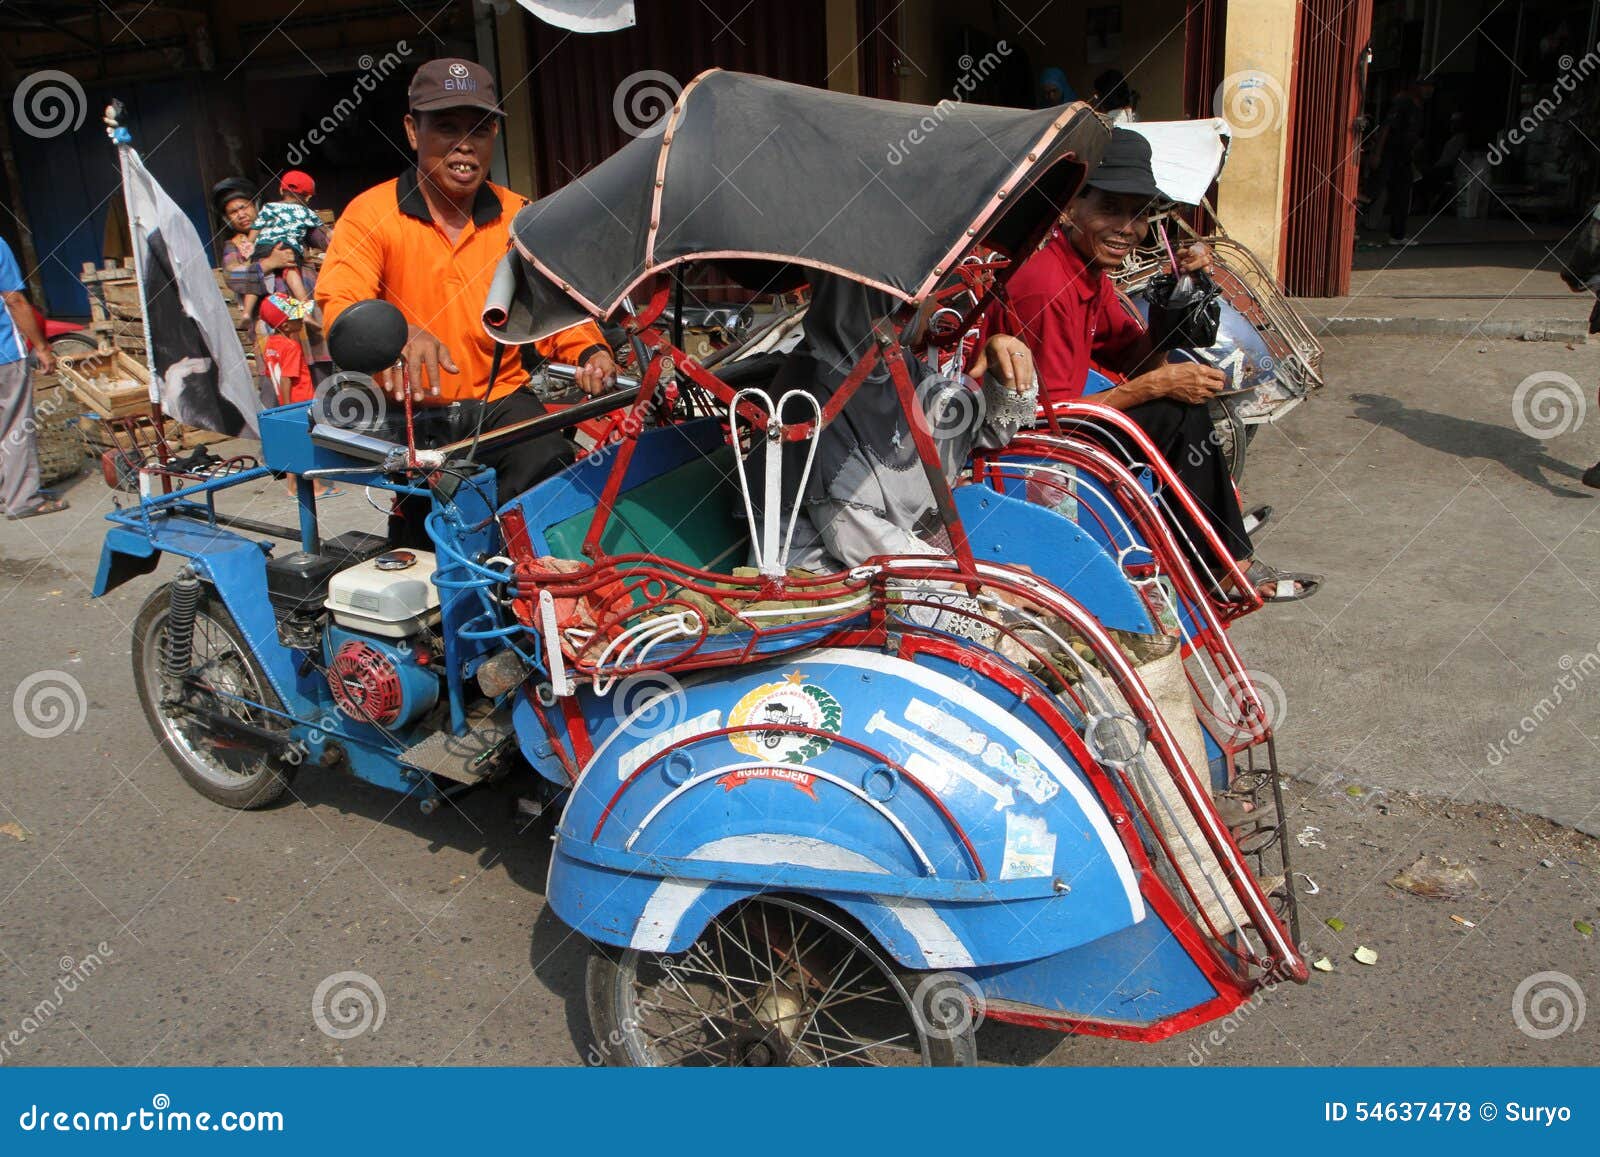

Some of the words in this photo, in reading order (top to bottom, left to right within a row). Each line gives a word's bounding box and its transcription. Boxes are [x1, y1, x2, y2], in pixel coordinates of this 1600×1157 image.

[444, 79, 477, 93] BMW
[737, 768, 769, 778] NGUDI
[772, 768, 809, 785] REJEKI
